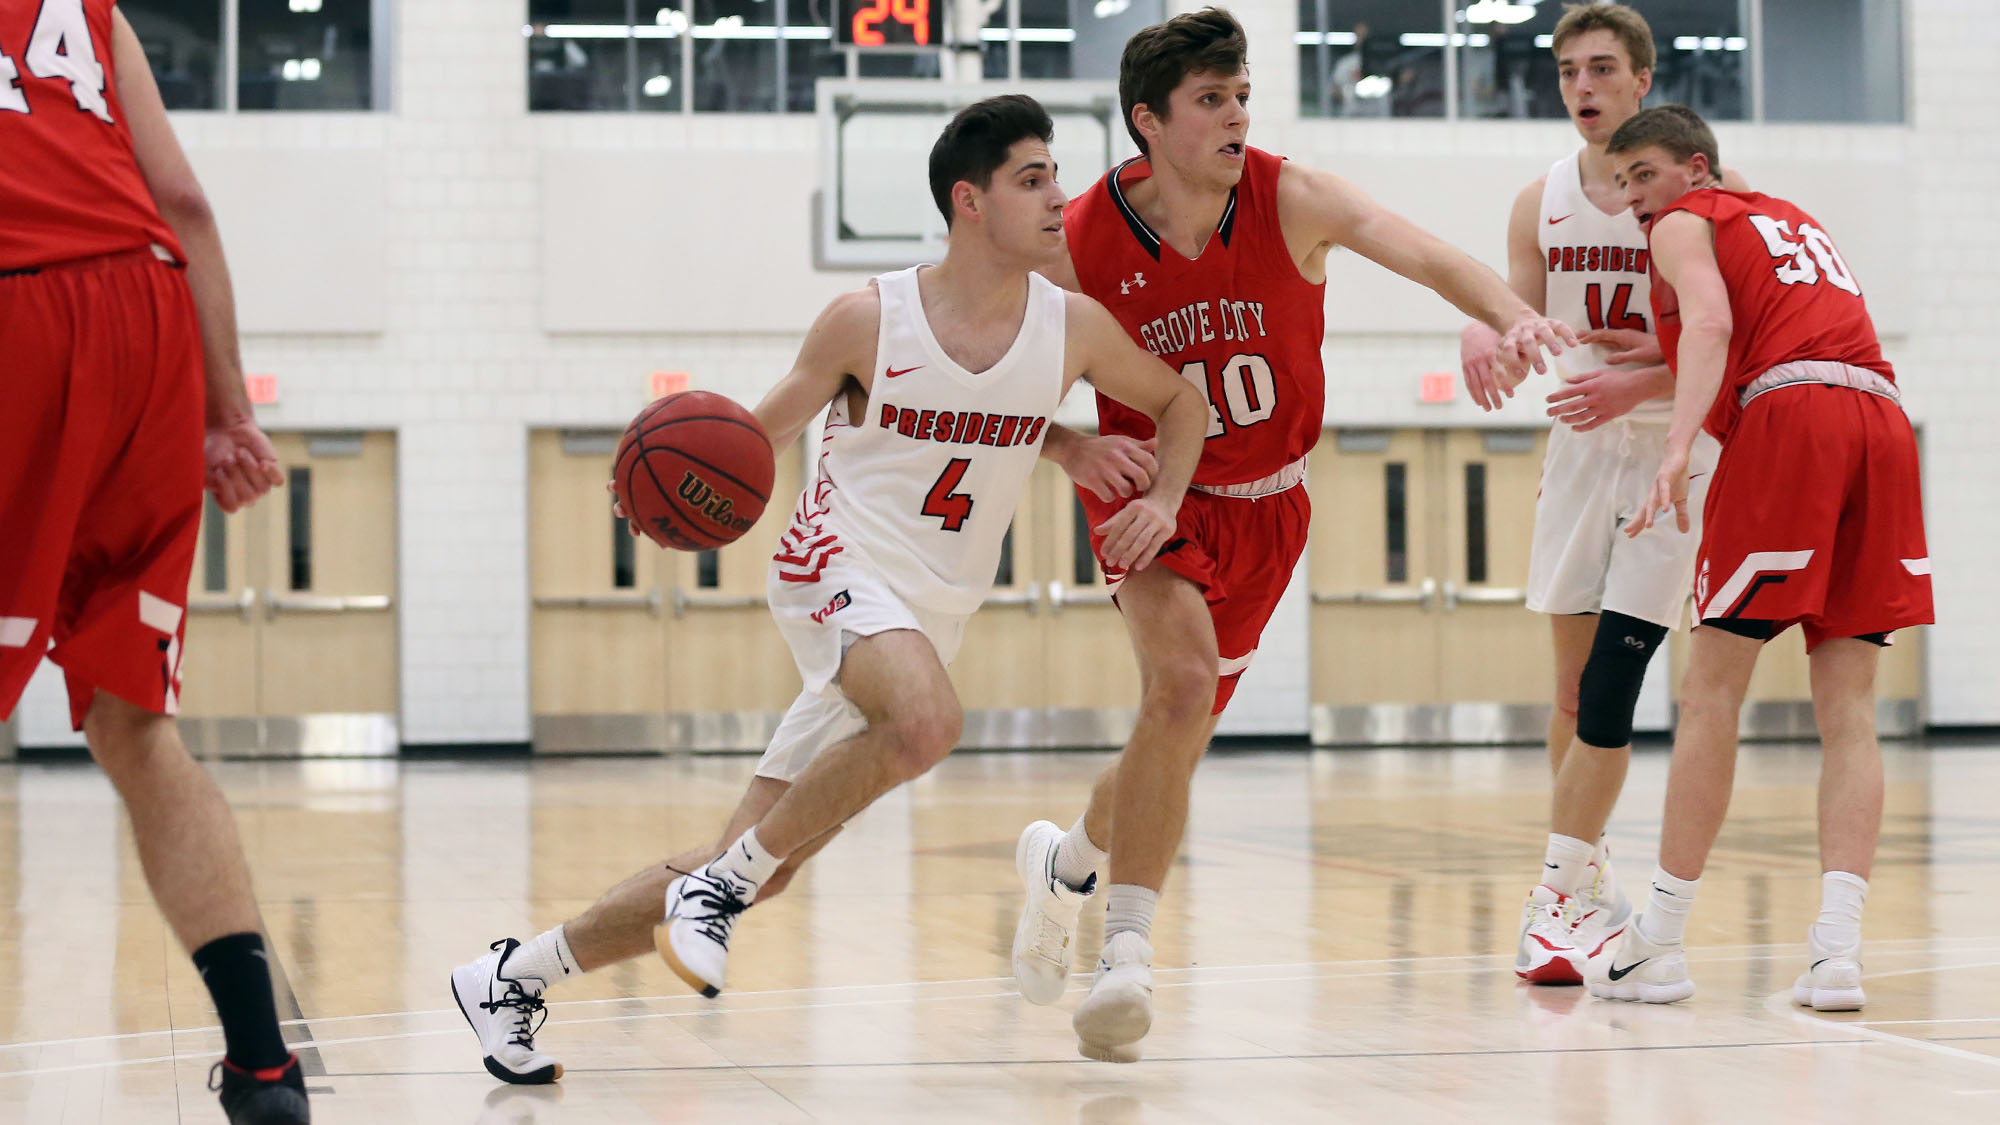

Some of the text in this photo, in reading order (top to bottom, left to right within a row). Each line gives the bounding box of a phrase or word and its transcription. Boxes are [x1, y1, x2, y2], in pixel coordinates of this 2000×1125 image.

[852, 0, 930, 47] 24
[1548, 246, 1650, 275] PRESIDEN
[1748, 213, 1863, 297] 50
[1140, 301, 1215, 356] GROVE
[1585, 283, 1647, 333] 14
[879, 403, 1046, 447] PRESIDENTS
[920, 457, 974, 532] 4
